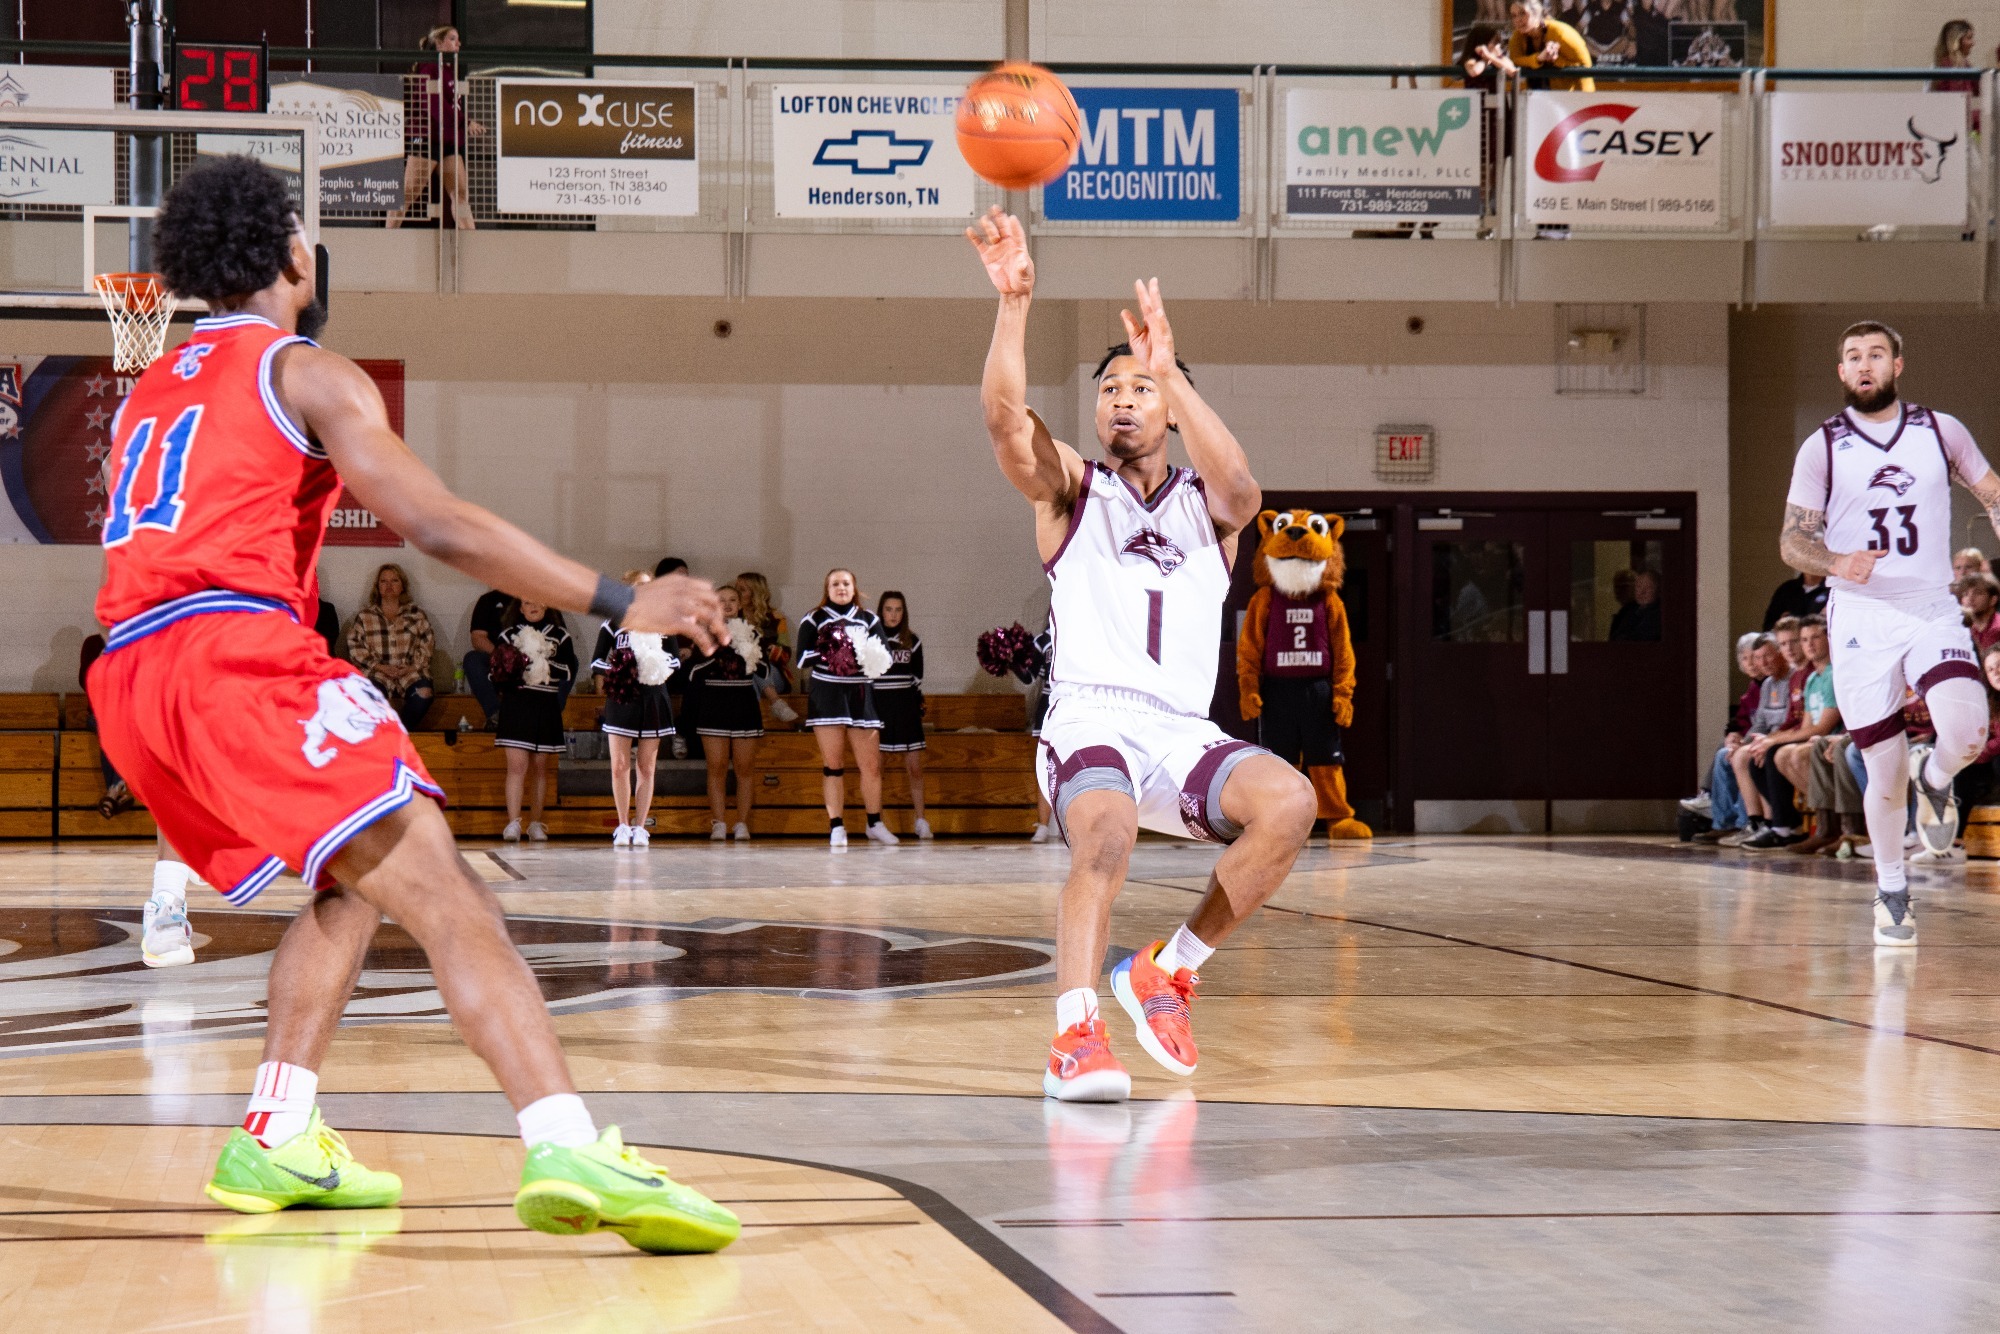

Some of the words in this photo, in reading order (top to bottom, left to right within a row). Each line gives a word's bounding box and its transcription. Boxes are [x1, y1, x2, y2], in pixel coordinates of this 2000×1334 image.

[180, 48, 258, 111] 28
[780, 95, 852, 114] LOFTON
[620, 131, 684, 154] fitness
[1069, 108, 1215, 166] MTM
[1298, 112, 1456, 157] anew
[1577, 129, 1714, 156] CASEY
[1781, 141, 1925, 167] SNOOKUM'S
[548, 167, 570, 179] 123
[574, 168, 606, 179] Front
[610, 168, 649, 179] Street
[1297, 166, 1348, 179] Family
[1357, 167, 1427, 179] Medical,
[1436, 167, 1471, 178] PLLC
[1780, 168, 1912, 181] STEAKHOUSE
[319, 177, 354, 190] Graphics
[363, 178, 399, 191] Magnets
[529, 180, 605, 193] Henderson,
[610, 181, 625, 192] TN
[629, 181, 667, 192] 38340
[1066, 171, 1215, 200] RECOGNITION
[1297, 188, 1317, 199] 111
[1320, 188, 1351, 199] Front
[1353, 188, 1369, 199] St.
[1386, 188, 1451, 201] Henderson,
[1455, 189, 1472, 200] TN
[319, 191, 341, 204] Signs
[350, 192, 371, 203] Yard
[372, 193, 395, 205] Signs
[556, 194, 642, 205] 731-435-1016
[808, 187, 912, 208] Henderson,
[916, 188, 939, 206] TN
[1340, 200, 1429, 213] 731-989-2829
[1533, 198, 1557, 211] 459
[1560, 199, 1573, 211] E.
[1576, 199, 1606, 211] Main
[1610, 199, 1647, 212] Street
[1388, 435, 1423, 461] EXIT
[102, 404, 205, 550] 11
[1867, 504, 1919, 558] 33
[1143, 588, 1164, 666] 1
[1293, 625, 1307, 649] 2
[1941, 648, 1971, 660] FHU
